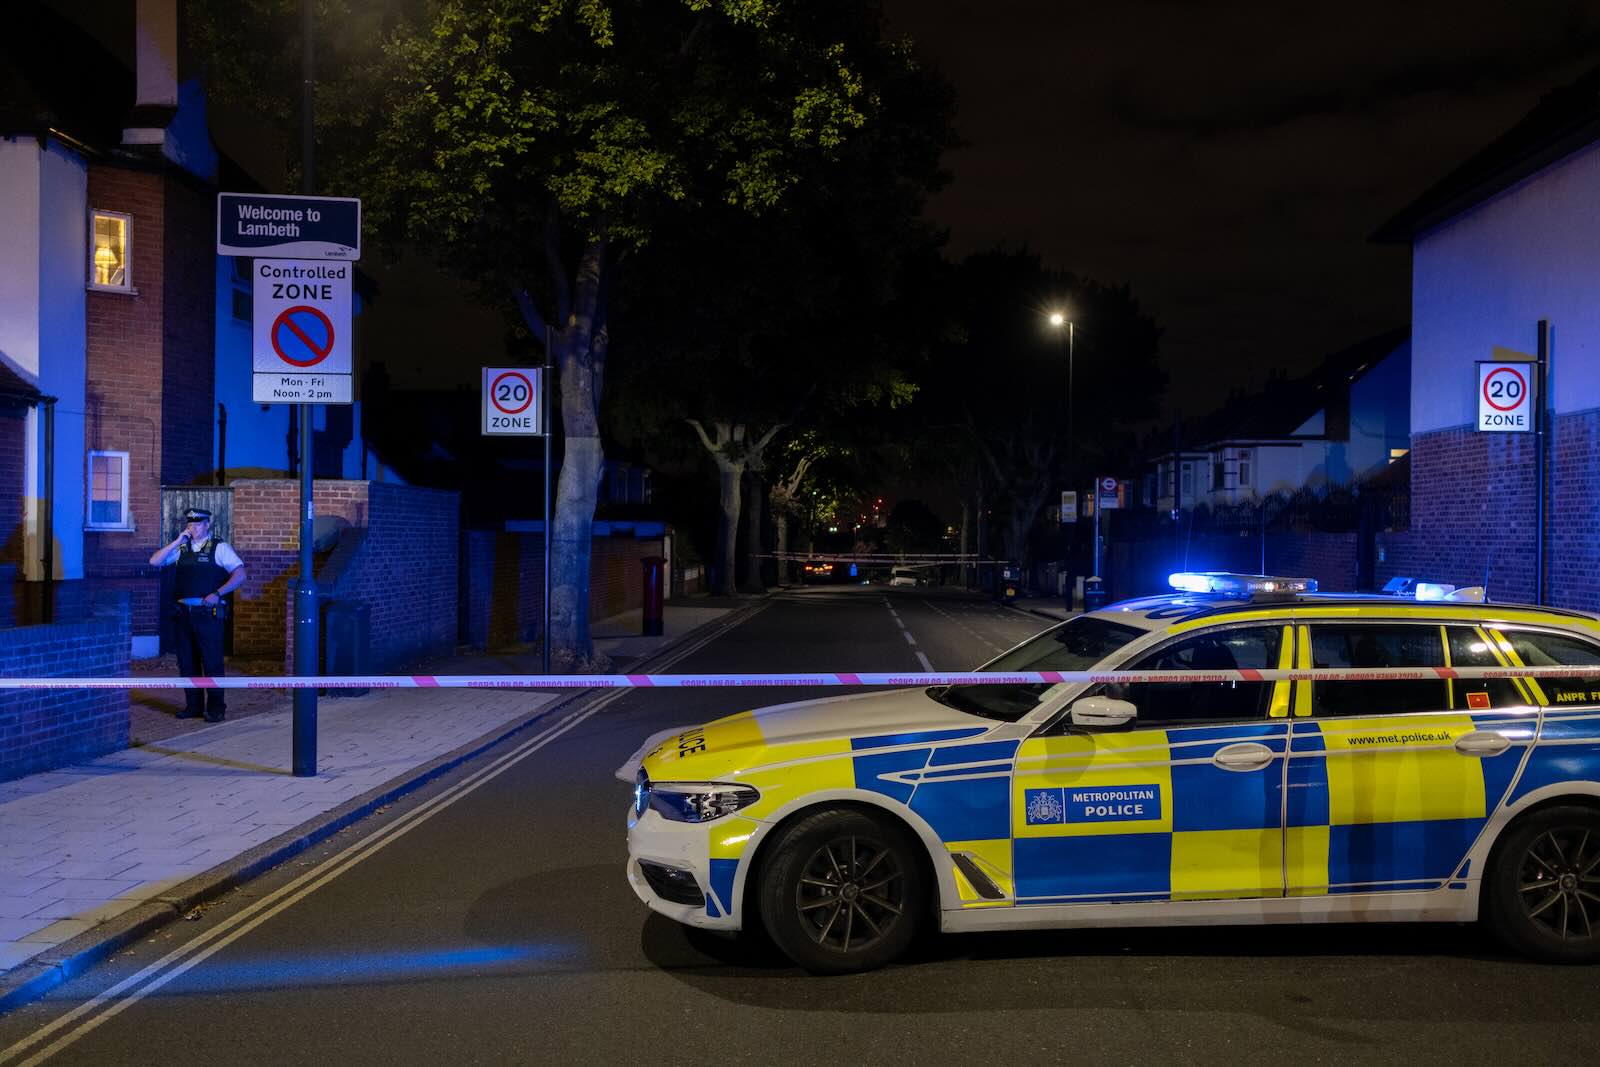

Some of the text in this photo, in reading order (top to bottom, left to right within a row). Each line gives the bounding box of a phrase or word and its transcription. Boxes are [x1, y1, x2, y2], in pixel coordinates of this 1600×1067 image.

[238, 205, 320, 222] Welcome to
[238, 221, 300, 237] Lambeth
[260, 265, 346, 279] Controlled
[272, 284, 332, 300] ZONE
[282, 378, 302, 386] Mon
[312, 378, 324, 386] Fri
[274, 390, 300, 398] Noon
[498, 384, 527, 402] 20
[1491, 380, 1520, 398] 20
[492, 418, 530, 428] ZONE
[1485, 414, 1524, 426] ZONE
[1556, 692, 1586, 702] ANPR
[1348, 731, 1450, 746] www.met.police.uk
[1072, 790, 1154, 802] METROPOLITAN
[1085, 804, 1144, 816] POLICE
